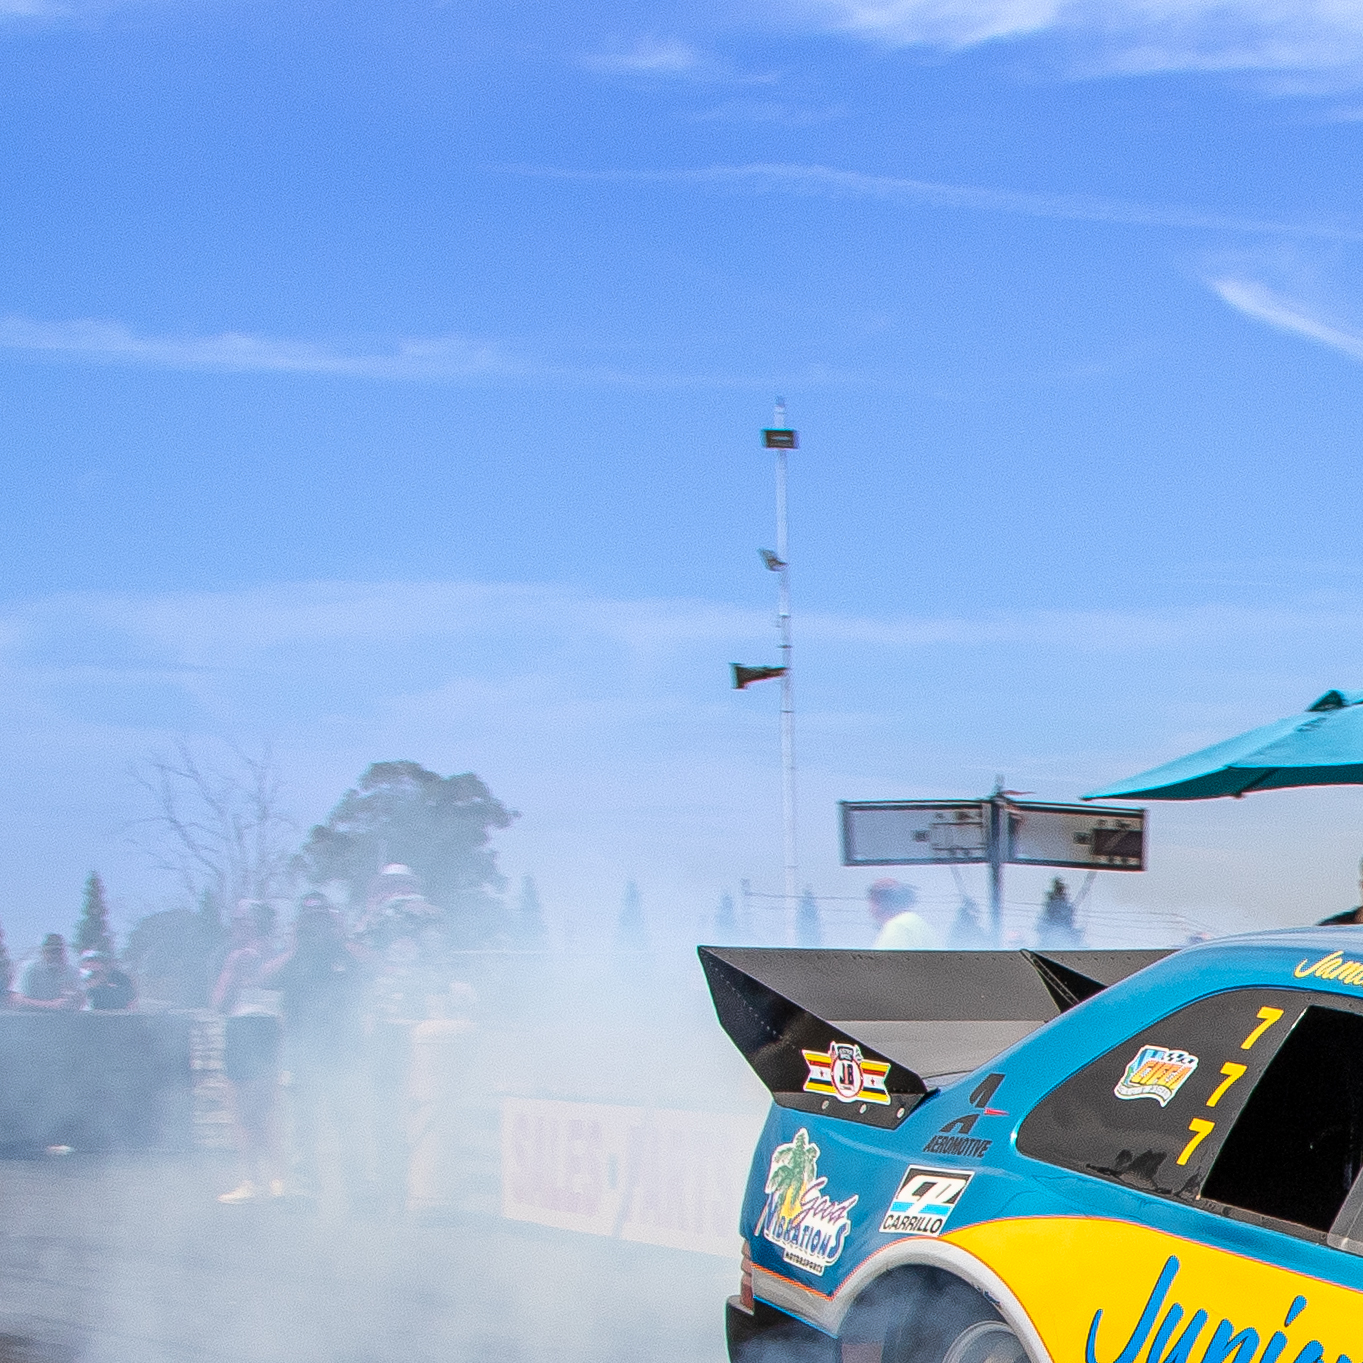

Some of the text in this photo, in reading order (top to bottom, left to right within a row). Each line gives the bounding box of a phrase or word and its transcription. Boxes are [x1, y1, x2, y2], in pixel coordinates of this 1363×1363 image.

[1240, 1006, 1284, 1050] 7
[1206, 1061, 1248, 1107] 7
[923, 1135, 993, 1158] AEROMOTIVE
[1176, 1118, 1216, 1166] 7
[882, 1213, 944, 1234] CARRILLO
